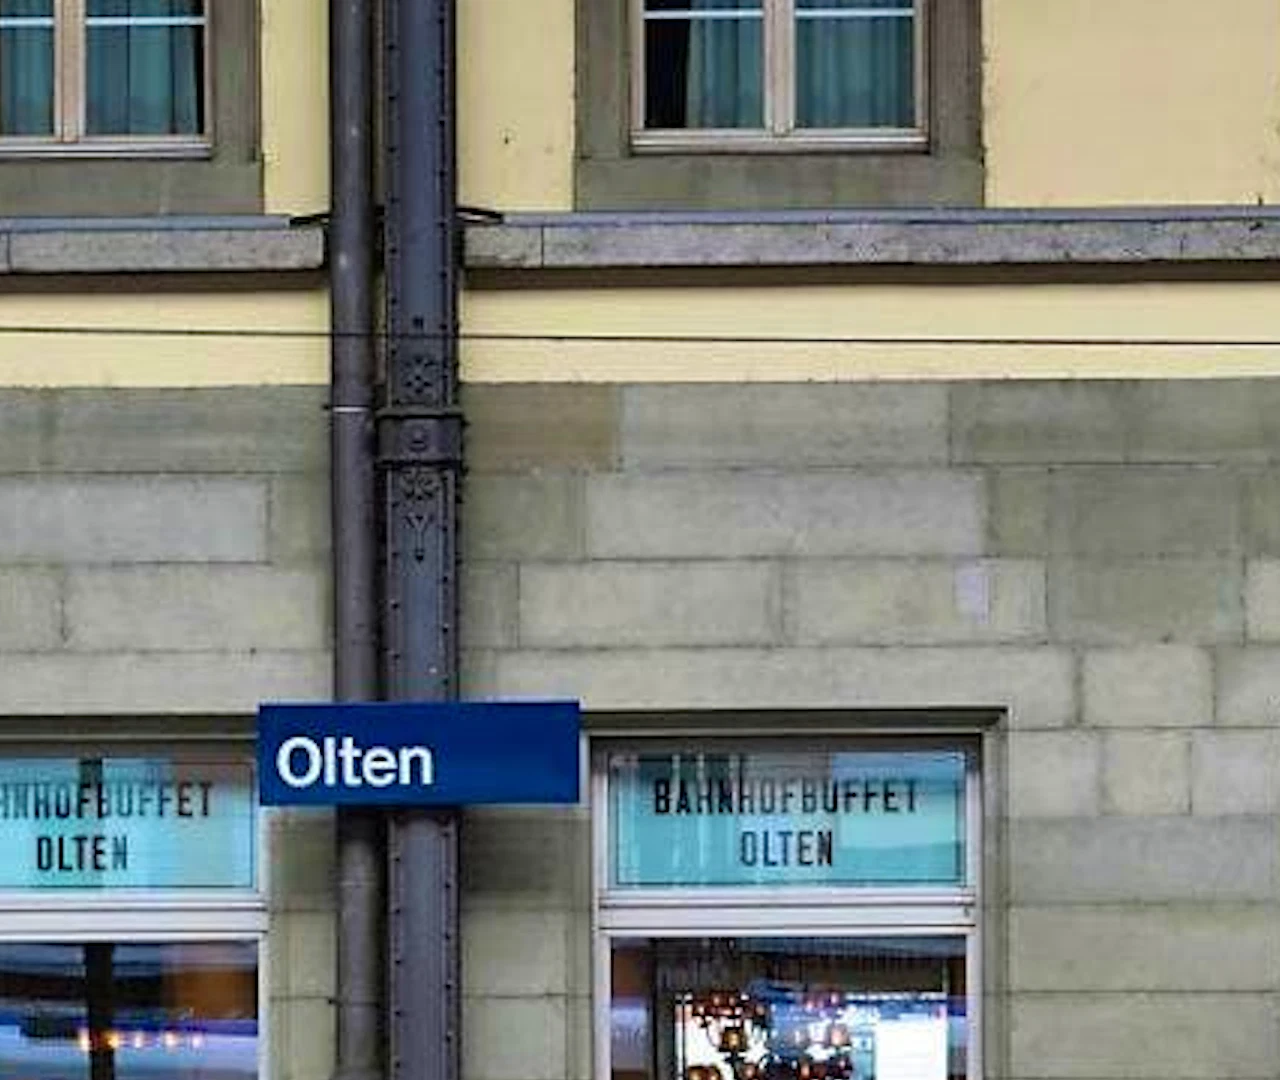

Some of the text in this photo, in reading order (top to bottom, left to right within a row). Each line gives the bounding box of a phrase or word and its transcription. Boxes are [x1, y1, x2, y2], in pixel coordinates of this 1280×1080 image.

[275, 735, 435, 790] Olten
[653, 776, 920, 816] BAHNHOFBUFFET
[34, 834, 129, 873] OLTEN
[739, 830, 834, 868] OLTEN
